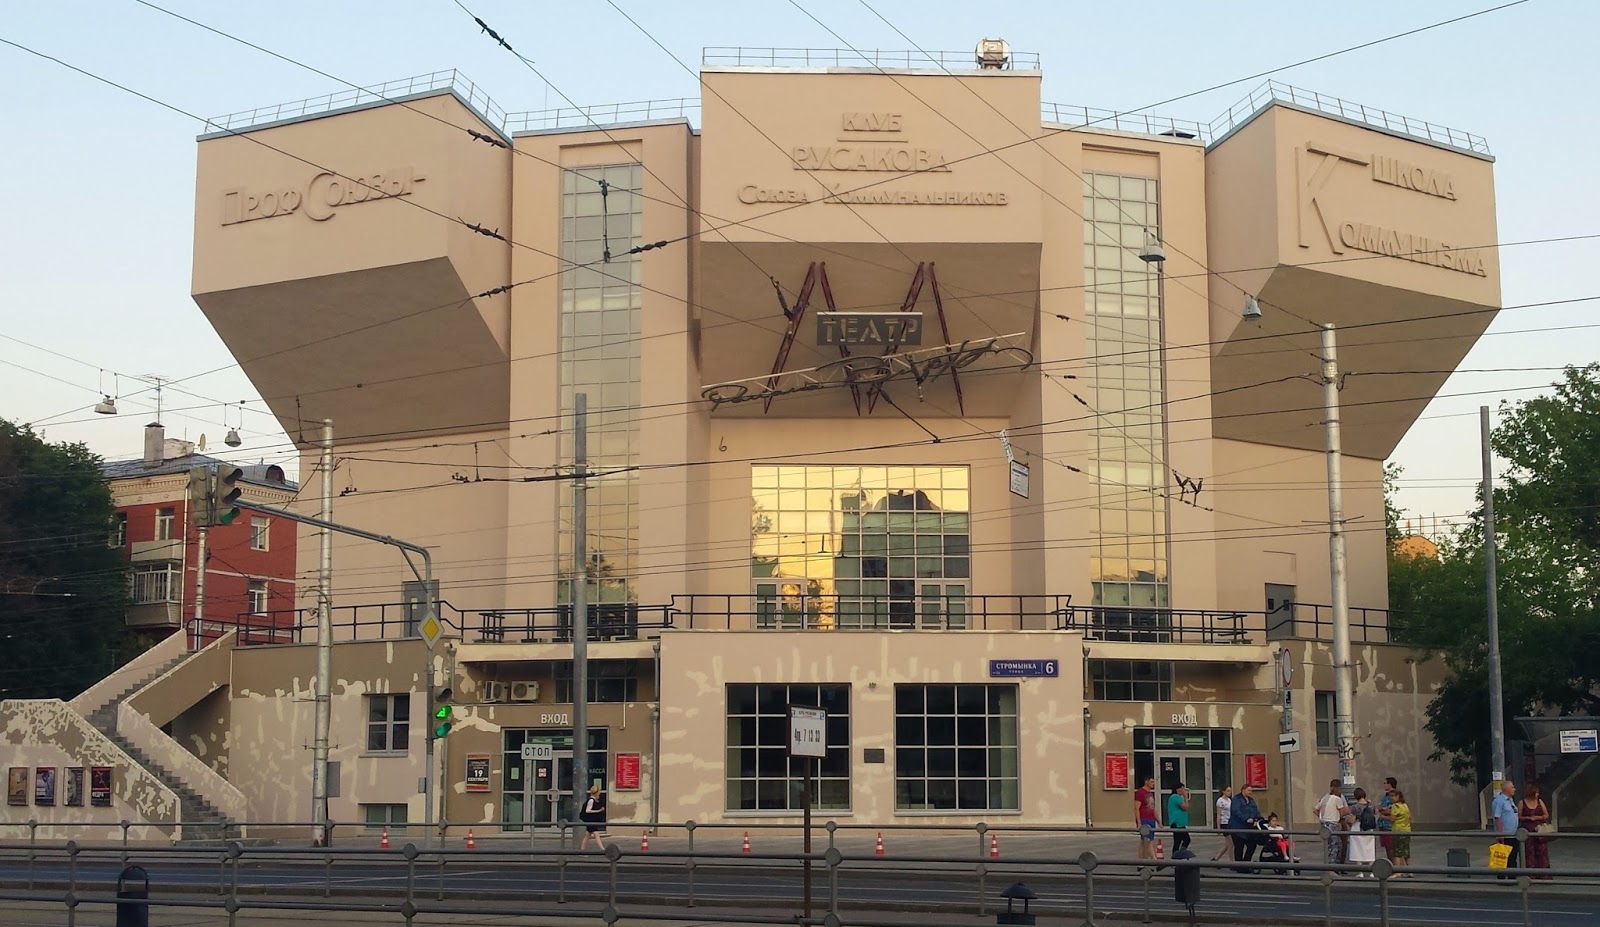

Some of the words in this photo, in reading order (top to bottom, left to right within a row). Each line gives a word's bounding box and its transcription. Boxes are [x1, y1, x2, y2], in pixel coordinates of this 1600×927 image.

[842, 112, 902, 132] КЛУБ
[792, 146, 952, 173] РУСАКОВА
[1372, 152, 1457, 201] ШКОЛА
[822, 318, 918, 342] ТЕАТР
[1045, 662, 1054, 674] 6
[541, 713, 569, 725] ВХОД
[1171, 713, 1197, 726] ВХОД
[524, 747, 550, 757] СТОП
[474, 769, 483, 777] 19
